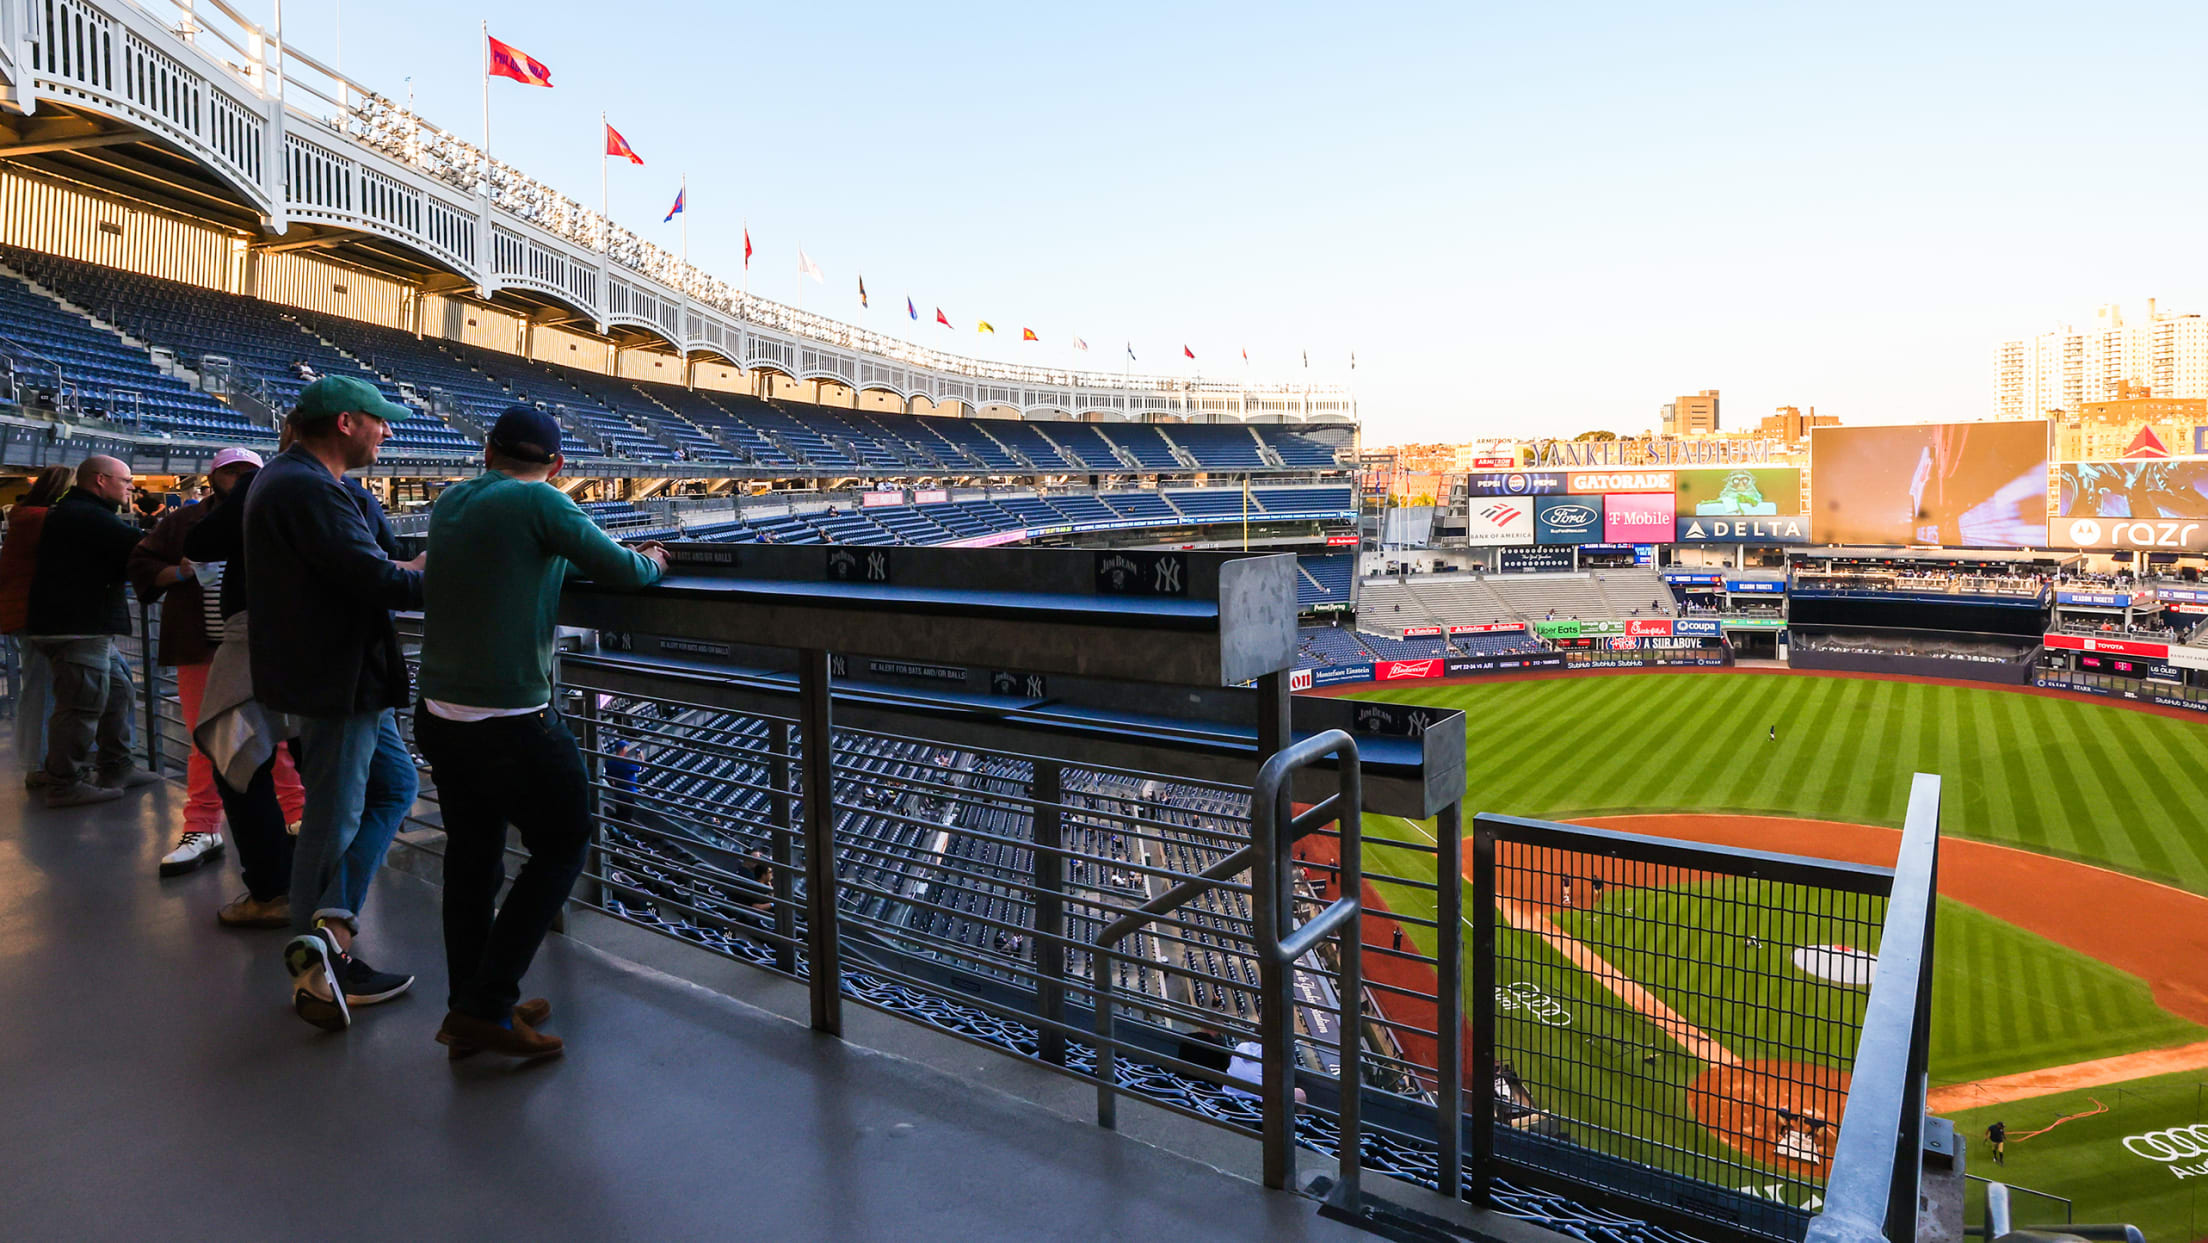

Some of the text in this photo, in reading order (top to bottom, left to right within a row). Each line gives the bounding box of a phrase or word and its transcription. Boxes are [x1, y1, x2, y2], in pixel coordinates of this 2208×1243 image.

[1531, 439, 1769, 467] YANKEE STADIUM
[1477, 480, 1500, 488] PEPSI
[1533, 479, 1557, 487] PEPSI
[1574, 474, 1670, 489] GATORADE
[1550, 508, 1587, 524] Ford
[1624, 511, 1670, 525] Mobile
[1714, 521, 1801, 537] DELTA
[2112, 522, 2200, 546] razr
[868, 550, 886, 580] NY
[1100, 555, 1137, 576] JIM BEAM
[1154, 556, 1182, 592] NY
[2072, 595, 2114, 604] SEASON TICKETS
[1557, 626, 1578, 634] Eats
[1689, 623, 1716, 632] coupa
[1644, 638, 1702, 648] A SUB ABOVE
[832, 655, 845, 676] NY
[879, 663, 895, 672] ALERT
[896, 665, 907, 673] FOR
[908, 666, 921, 675] BATS
[923, 668, 946, 677] AND/OR
[947, 670, 966, 679] BALLS
[1346, 666, 1370, 675] Einstein
[1393, 665, 1429, 674] Budweiser
[2160, 667, 2177, 675] OLED
[1027, 674, 1042, 696] NY
[2155, 696, 2207, 711] StubHub StubHub
[1358, 706, 1392, 724] JIM BEAM
